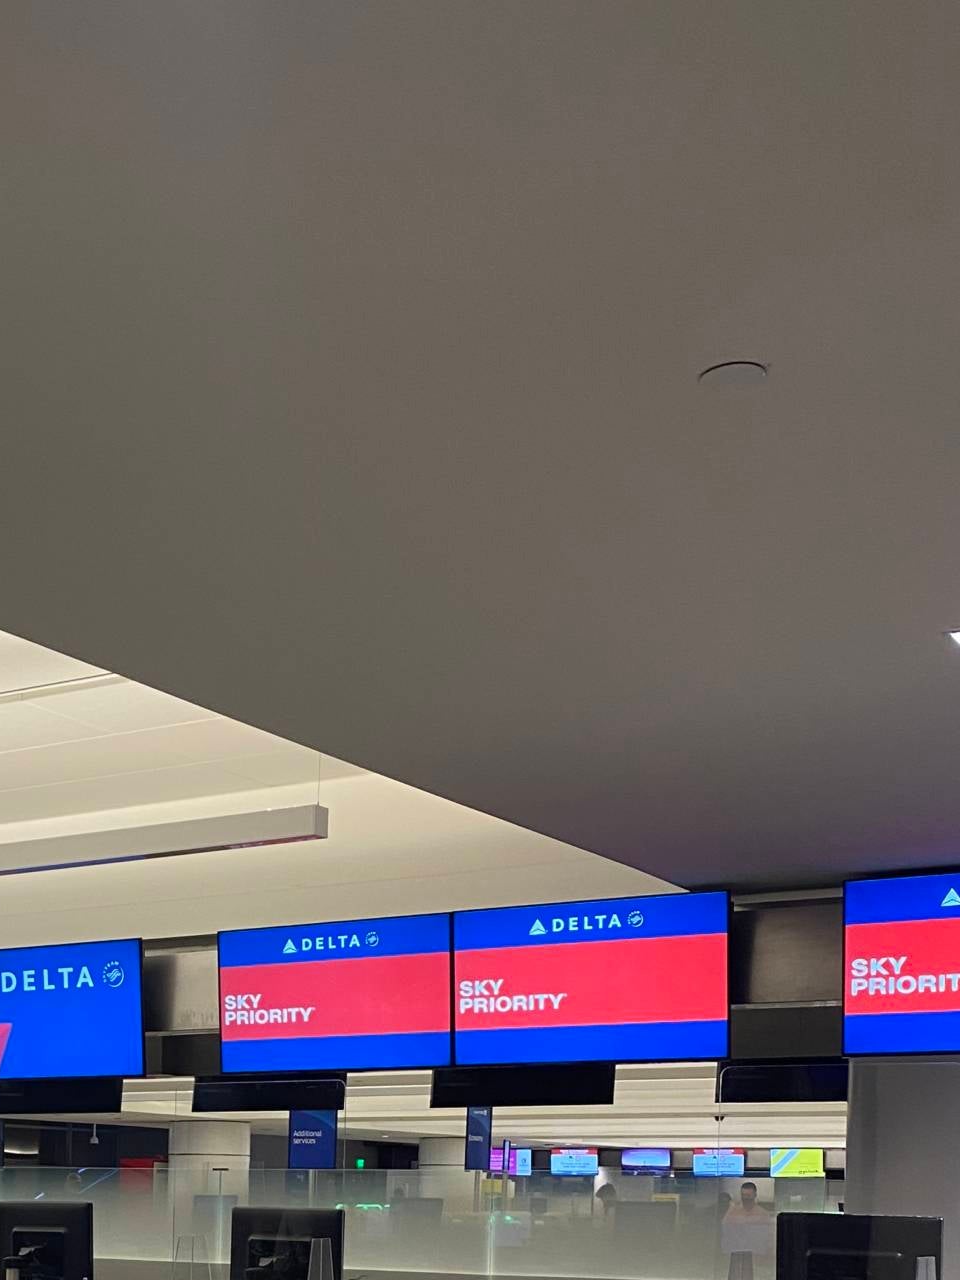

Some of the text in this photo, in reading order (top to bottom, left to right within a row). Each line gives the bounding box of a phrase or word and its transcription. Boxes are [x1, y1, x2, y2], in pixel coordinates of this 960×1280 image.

[552, 914, 621, 932] DELTA
[302, 934, 360, 951] DELTA
[851, 956, 907, 977] SKY
[1, 966, 94, 993] DELTA
[460, 979, 504, 997] SKY
[851, 973, 960, 997] PRIORIT
[225, 994, 261, 1010] SKY
[460, 993, 563, 1014] PRIORITY
[225, 1007, 312, 1026] PRIORITY
